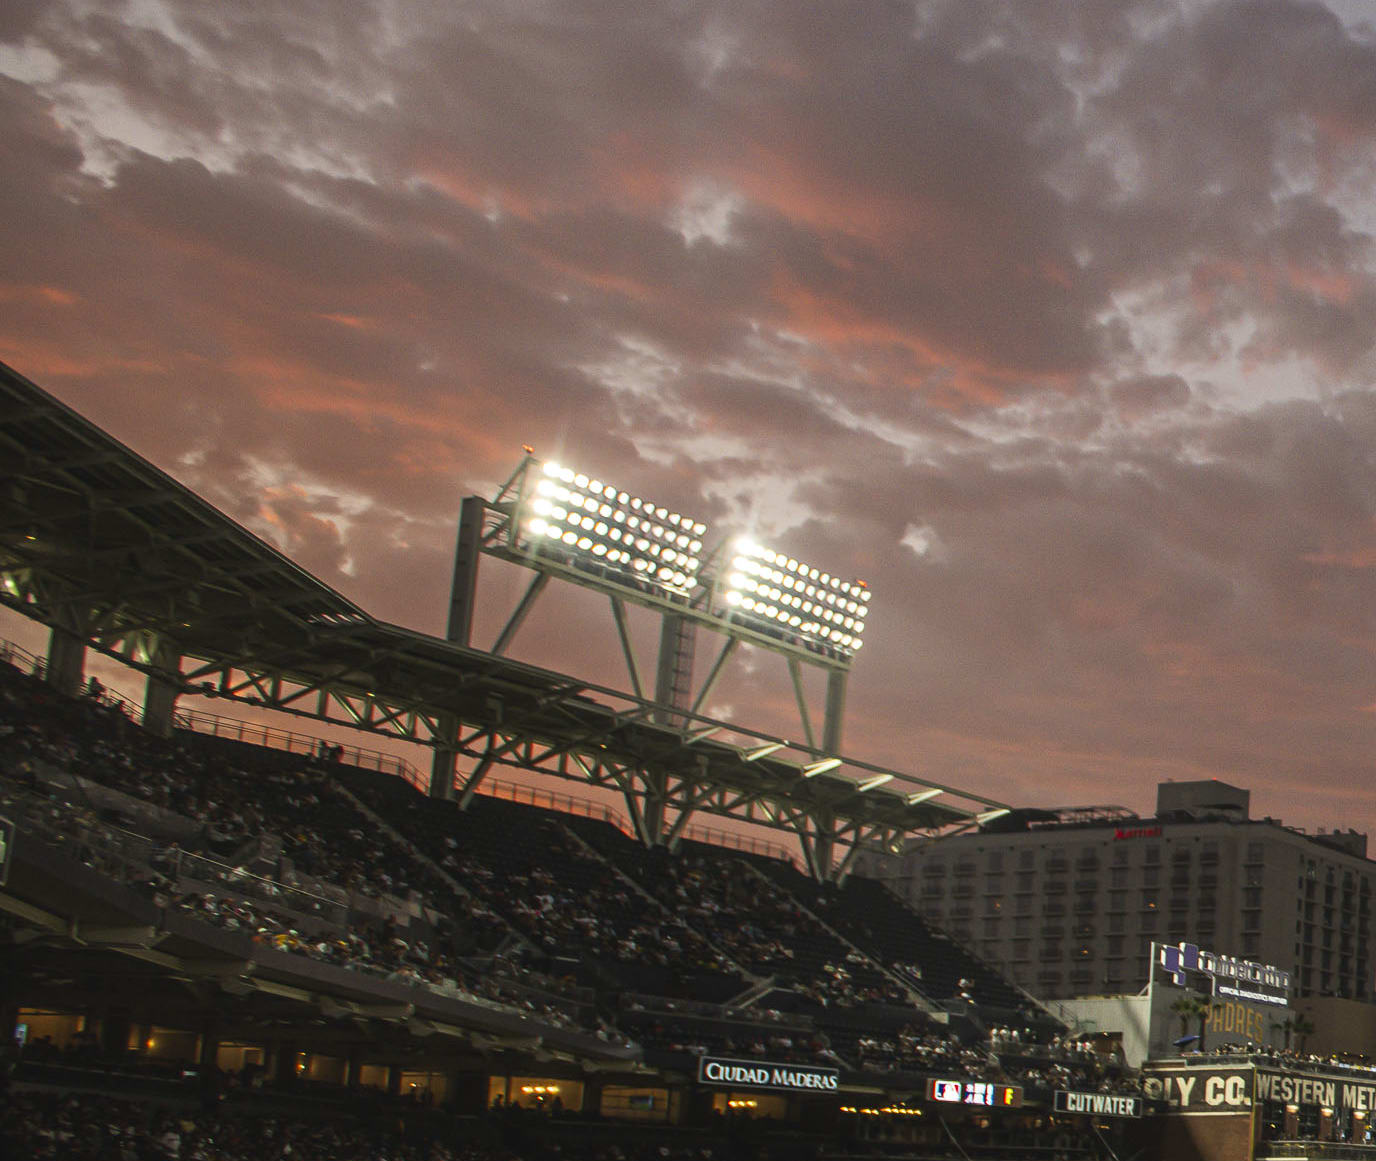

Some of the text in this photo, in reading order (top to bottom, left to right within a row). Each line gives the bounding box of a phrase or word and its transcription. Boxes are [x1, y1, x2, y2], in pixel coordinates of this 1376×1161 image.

[705, 1062, 838, 1090] CIUDAD MADERAS
[1256, 1073, 1335, 1107] WESTERN
[1066, 1092, 1135, 1116] CUTWATER
[1205, 1076, 1251, 1107] CO.
